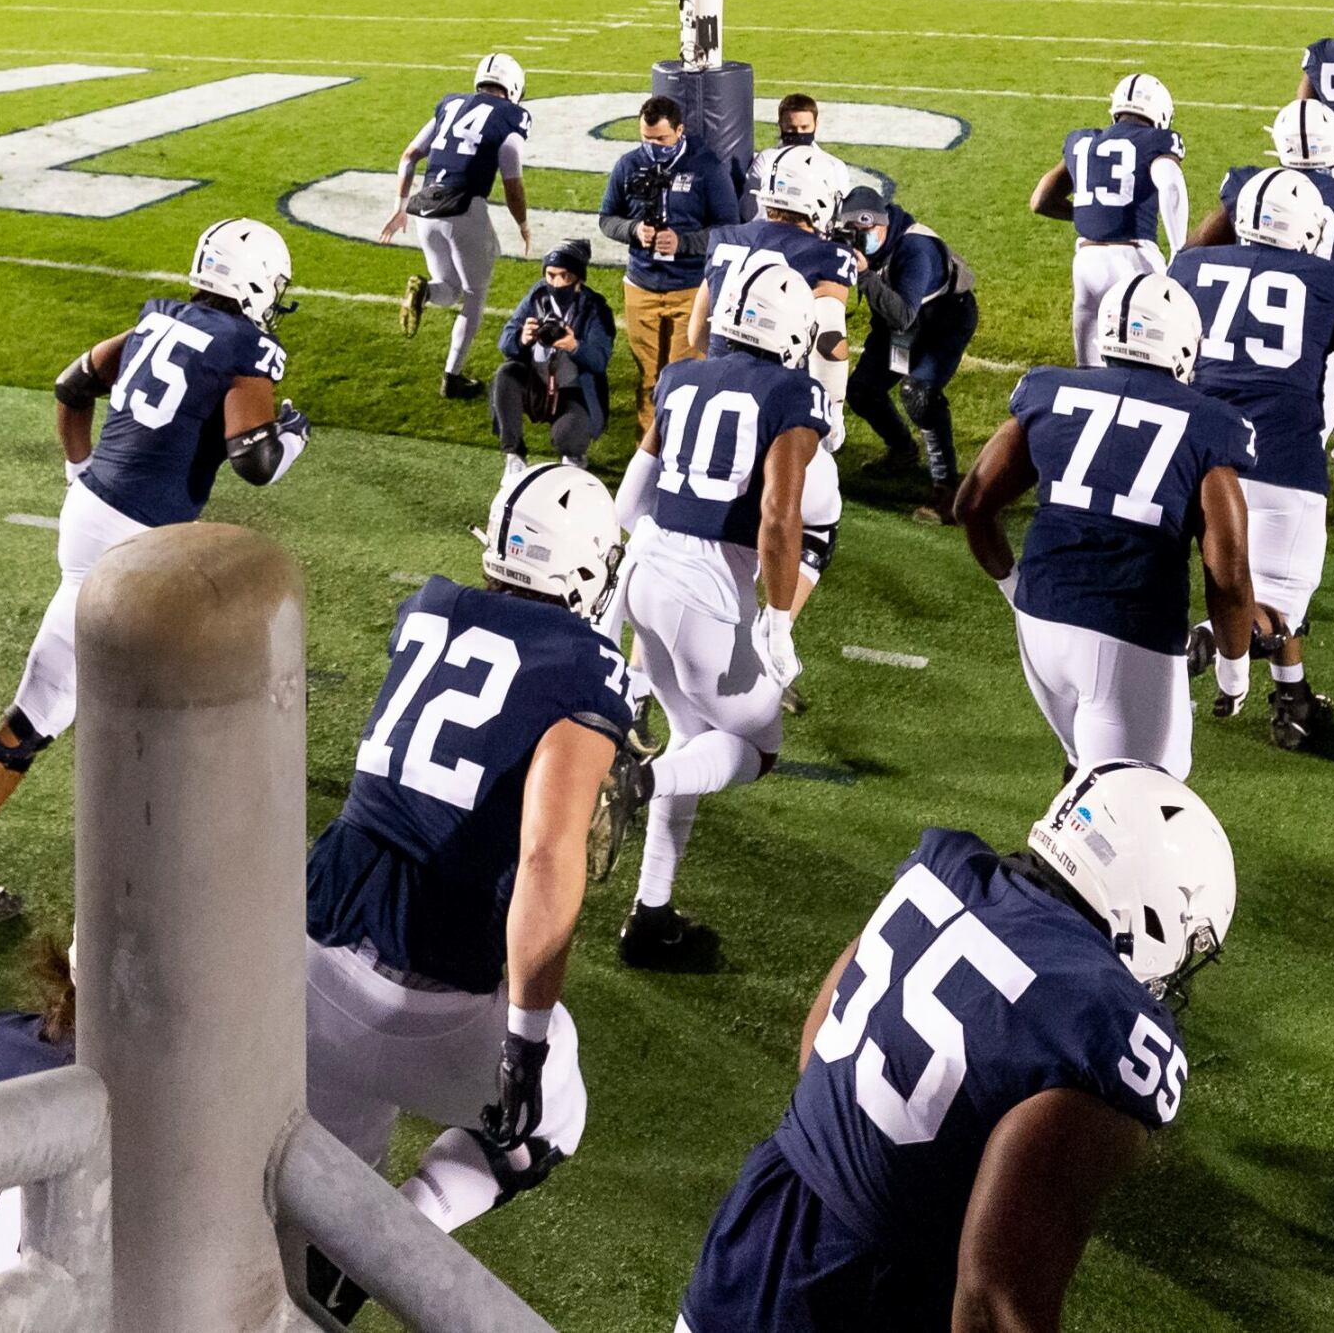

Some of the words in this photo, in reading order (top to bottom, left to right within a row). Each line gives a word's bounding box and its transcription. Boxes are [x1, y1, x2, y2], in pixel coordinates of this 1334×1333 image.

[430, 99, 494, 156] 14
[1072, 136, 1137, 207] 13
[109, 311, 214, 431] 75
[254, 335, 287, 383] 75
[1197, 262, 1307, 370] 79
[655, 384, 760, 503] 10
[1049, 386, 1191, 527] 77
[506, 567, 532, 585] UNITED
[355, 611, 522, 811] 72
[812, 862, 1038, 1146] 55
[1118, 1012, 1188, 1126] 55
